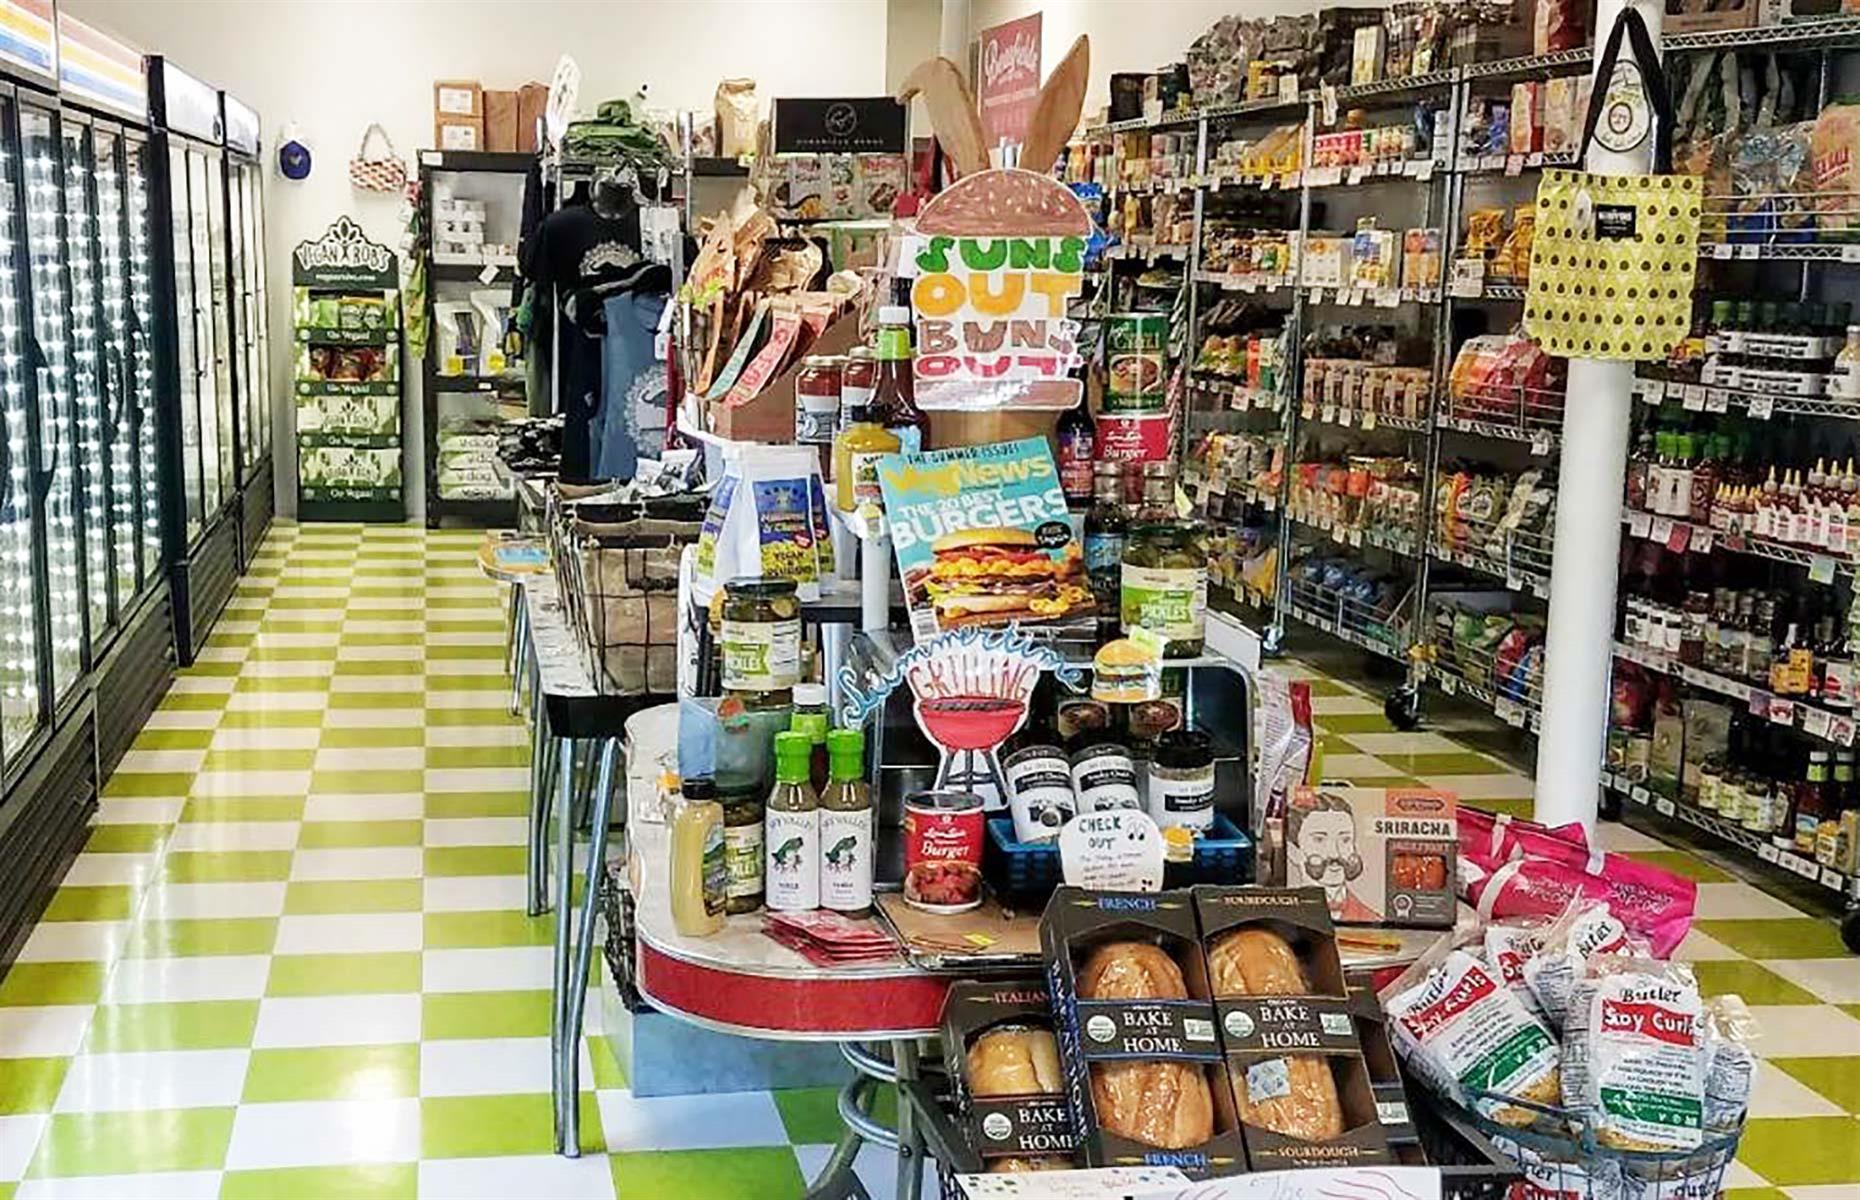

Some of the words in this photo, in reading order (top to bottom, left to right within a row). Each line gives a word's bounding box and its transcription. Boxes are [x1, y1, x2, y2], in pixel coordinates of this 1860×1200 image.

[297, 243, 339, 269] VEGAN
[915, 236, 1086, 273] SUNS
[914, 272, 1082, 317] OUT
[932, 447, 978, 464] SUMMER
[1103, 444, 1149, 462] Burger
[889, 487, 1068, 550] BURGERS
[908, 653, 1037, 700] GRILLING
[1079, 816, 1122, 833] CHECK
[1375, 820, 1451, 837] SRIRACHA
[920, 840, 970, 859] Burger
[1088, 836, 1116, 850] OUT
[1098, 897, 1157, 911] FRENCH
[1443, 974, 1487, 1012] Curls
[1620, 985, 1682, 1003] Butler
[1122, 1010, 1174, 1027] BAKE
[1260, 1006, 1310, 1022] BAKE
[1604, 1007, 1645, 1033] Soy
[1145, 1026, 1158, 1036] AT
[1282, 1022, 1296, 1031] AT
[1123, 1037, 1184, 1053] HOME
[1261, 1031, 1321, 1049] HOME
[1018, 1107, 1068, 1123] BAKE
[1041, 1123, 1053, 1132] AT
[1144, 1153, 1207, 1167] FRENCH
[1278, 1145, 1359, 1158] SOURDOUGH
